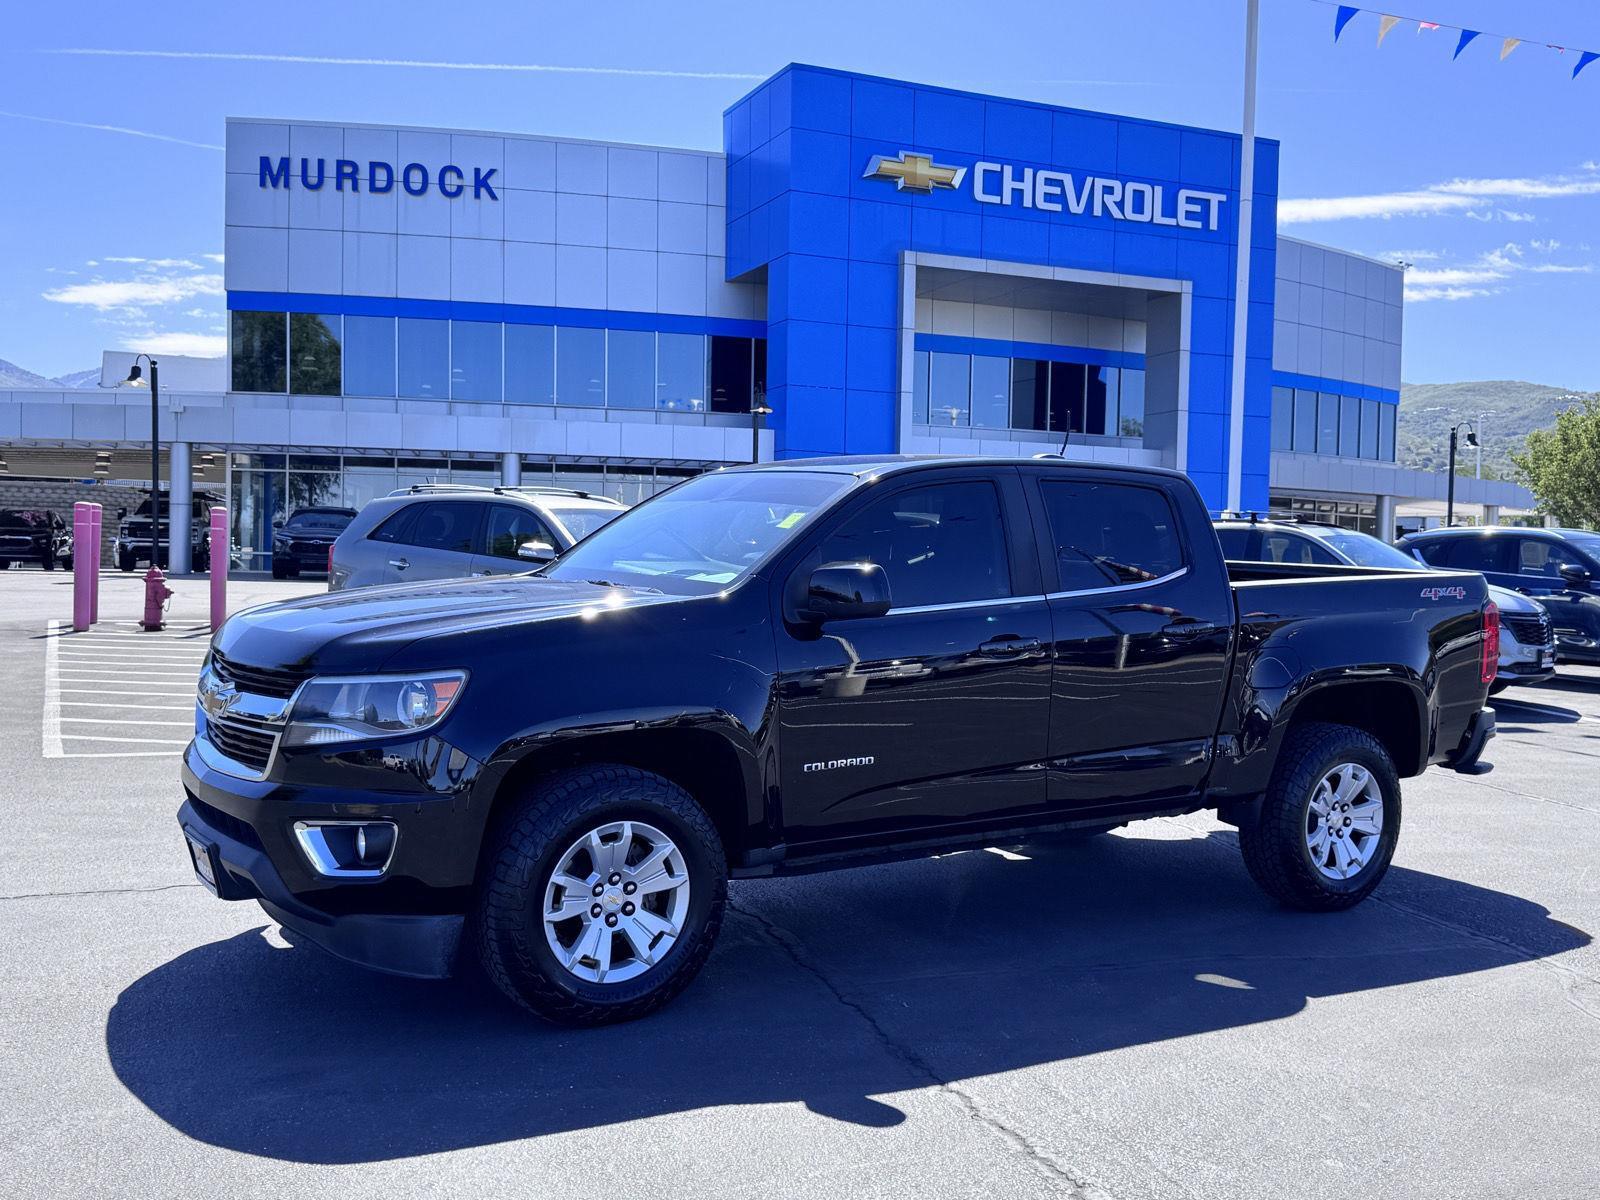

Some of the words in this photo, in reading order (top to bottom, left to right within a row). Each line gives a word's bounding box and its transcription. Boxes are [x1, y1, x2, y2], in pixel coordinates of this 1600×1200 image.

[259, 156, 499, 201] MURDOCK
[973, 161, 1226, 231] CHEVROLET
[803, 756, 875, 772] COLORADO
